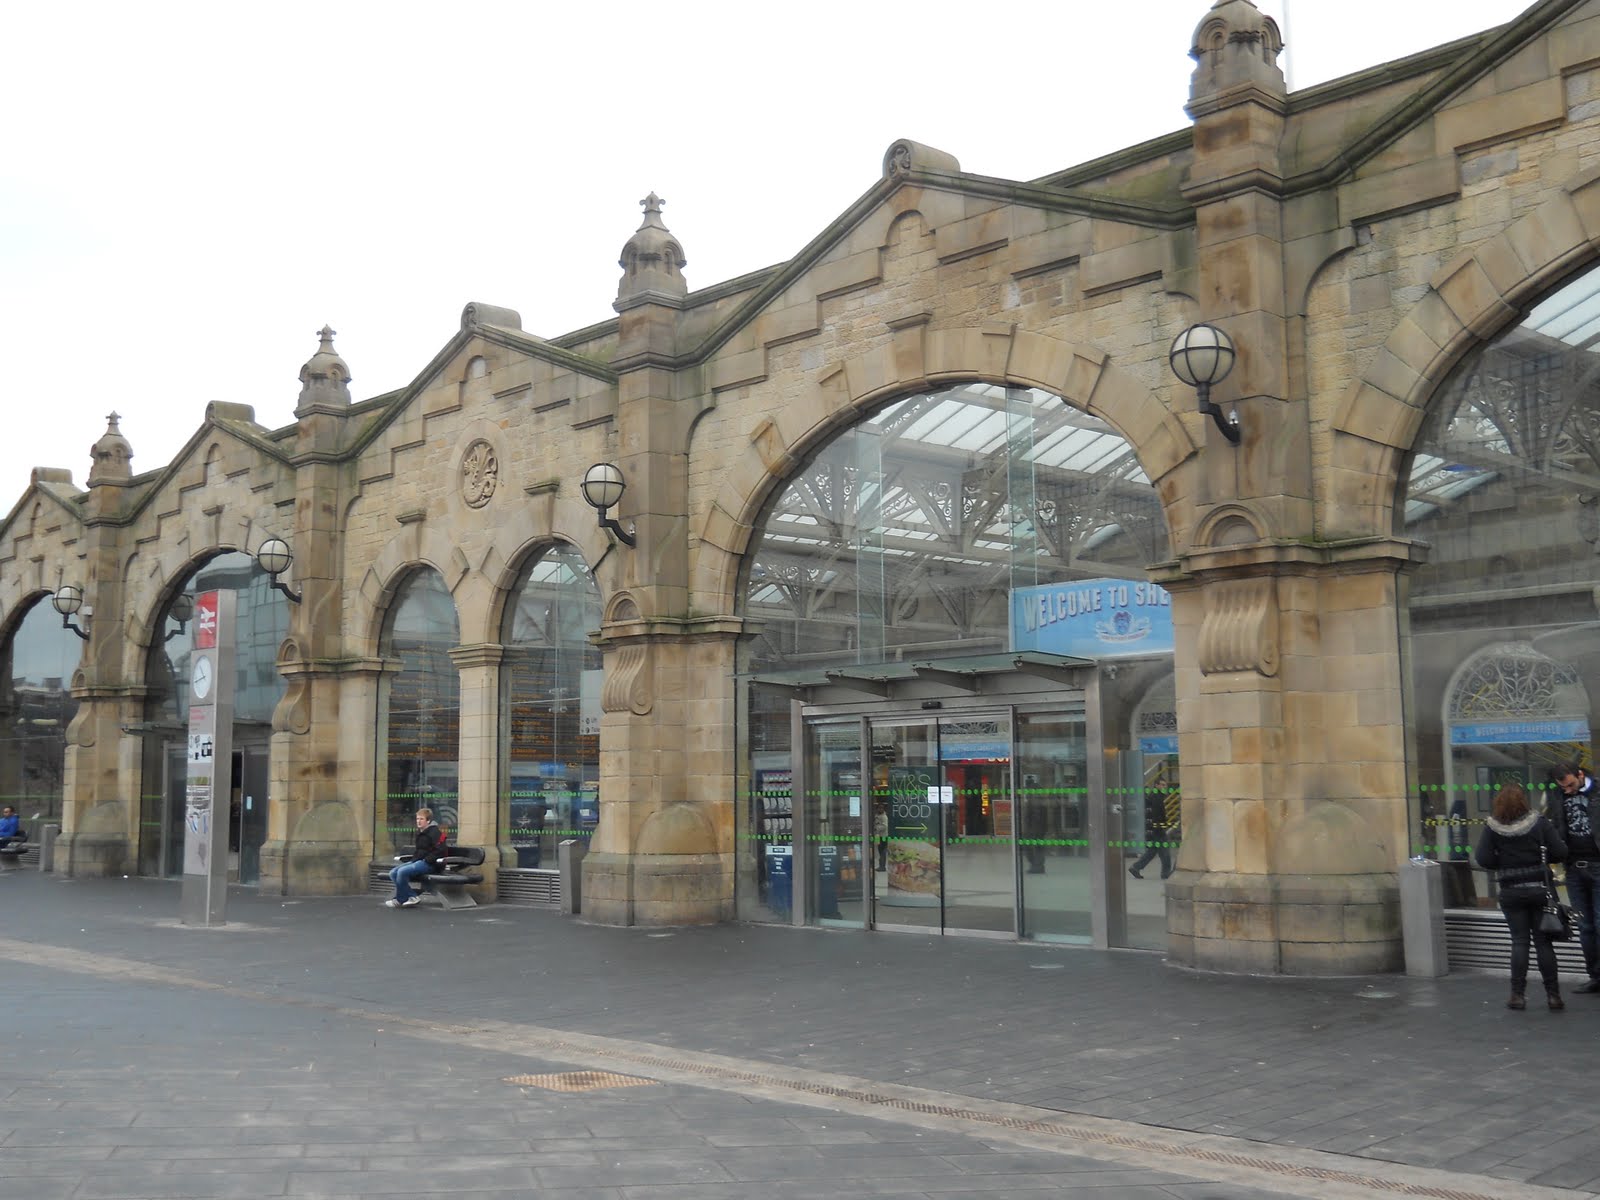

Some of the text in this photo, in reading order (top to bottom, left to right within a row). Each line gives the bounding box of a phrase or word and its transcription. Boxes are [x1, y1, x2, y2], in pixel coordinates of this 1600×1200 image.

[1023, 589, 1102, 633] WELCOME
[1109, 586, 1128, 608] TO
[892, 774, 931, 793] M&S
[892, 804, 931, 818] FOOD
